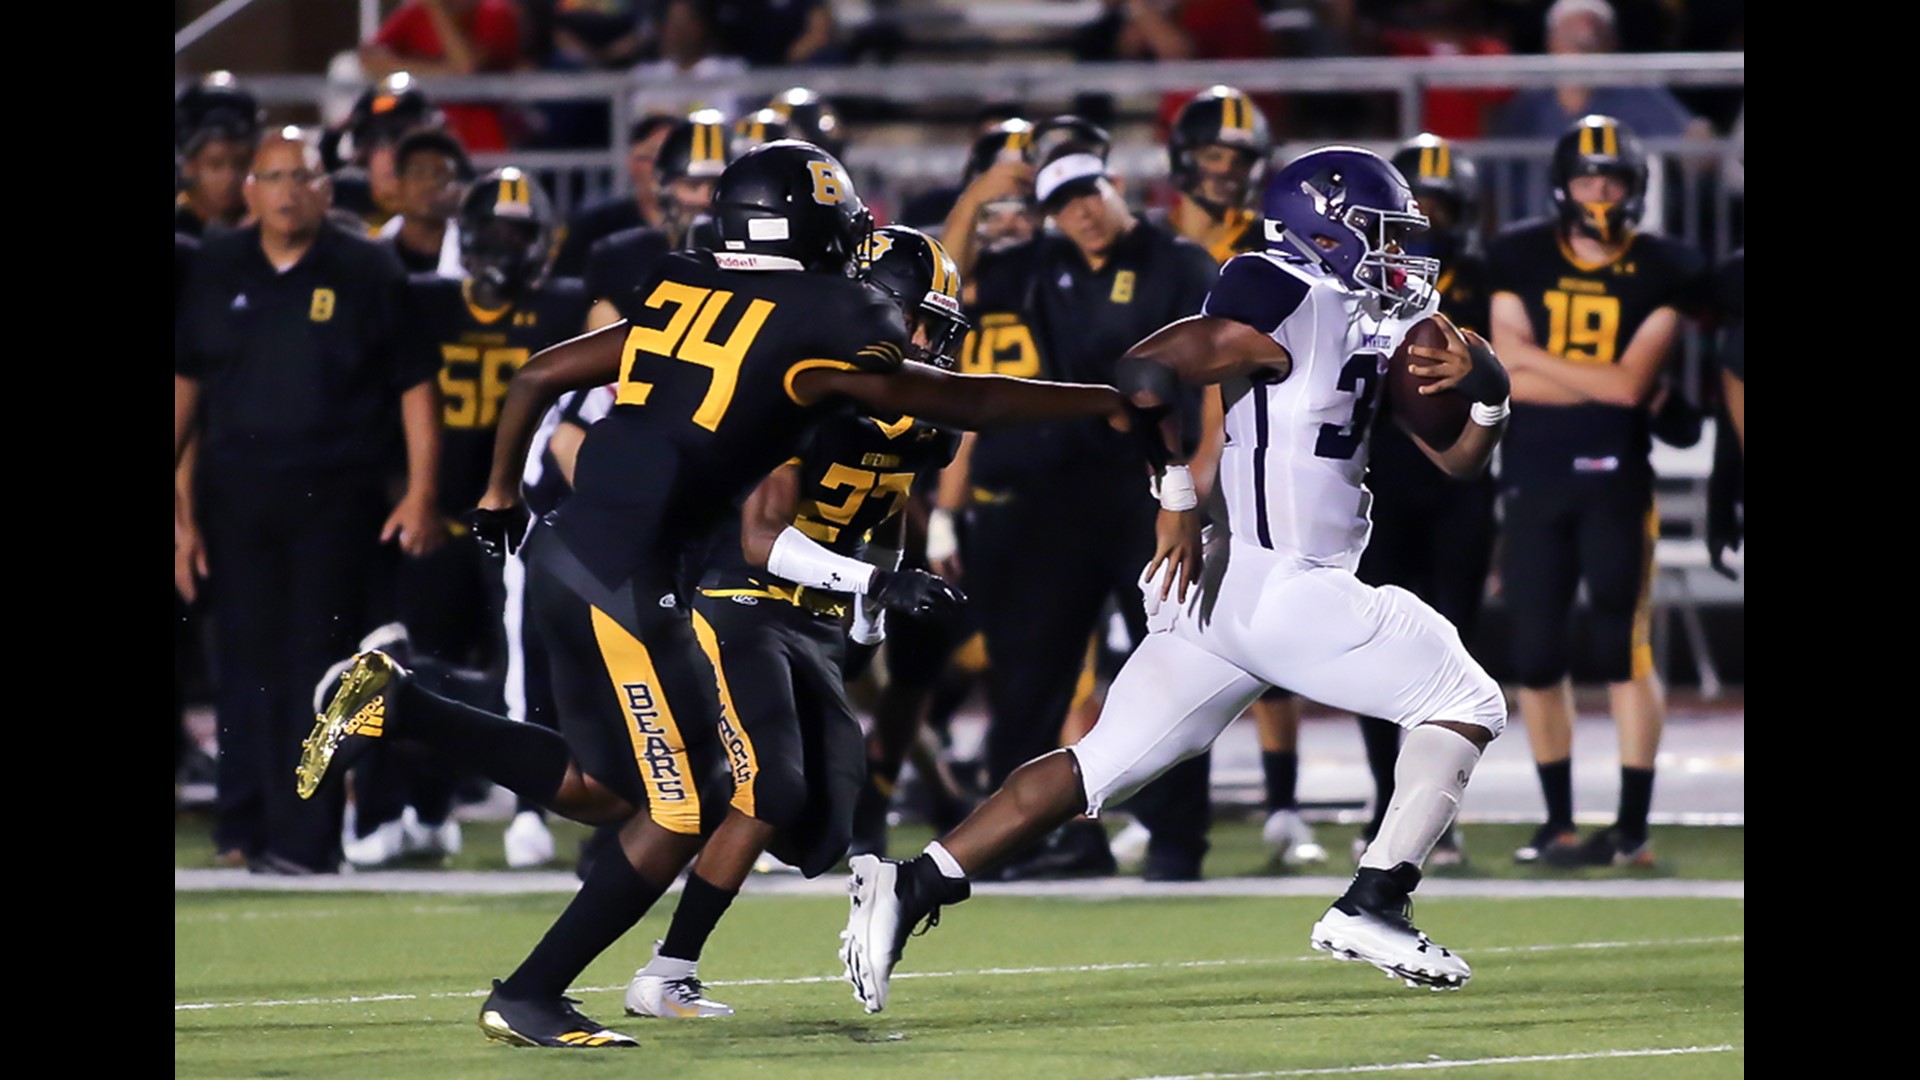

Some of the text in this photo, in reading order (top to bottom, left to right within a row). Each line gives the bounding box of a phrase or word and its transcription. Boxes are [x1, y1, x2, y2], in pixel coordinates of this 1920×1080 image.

[807, 160, 845, 206] B
[310, 288, 335, 321] B
[1543, 290, 1621, 364] 19
[615, 279, 777, 433] 24
[792, 462, 916, 544] 27
[342, 695, 384, 736] adidas
[622, 683, 687, 801] BEARS
